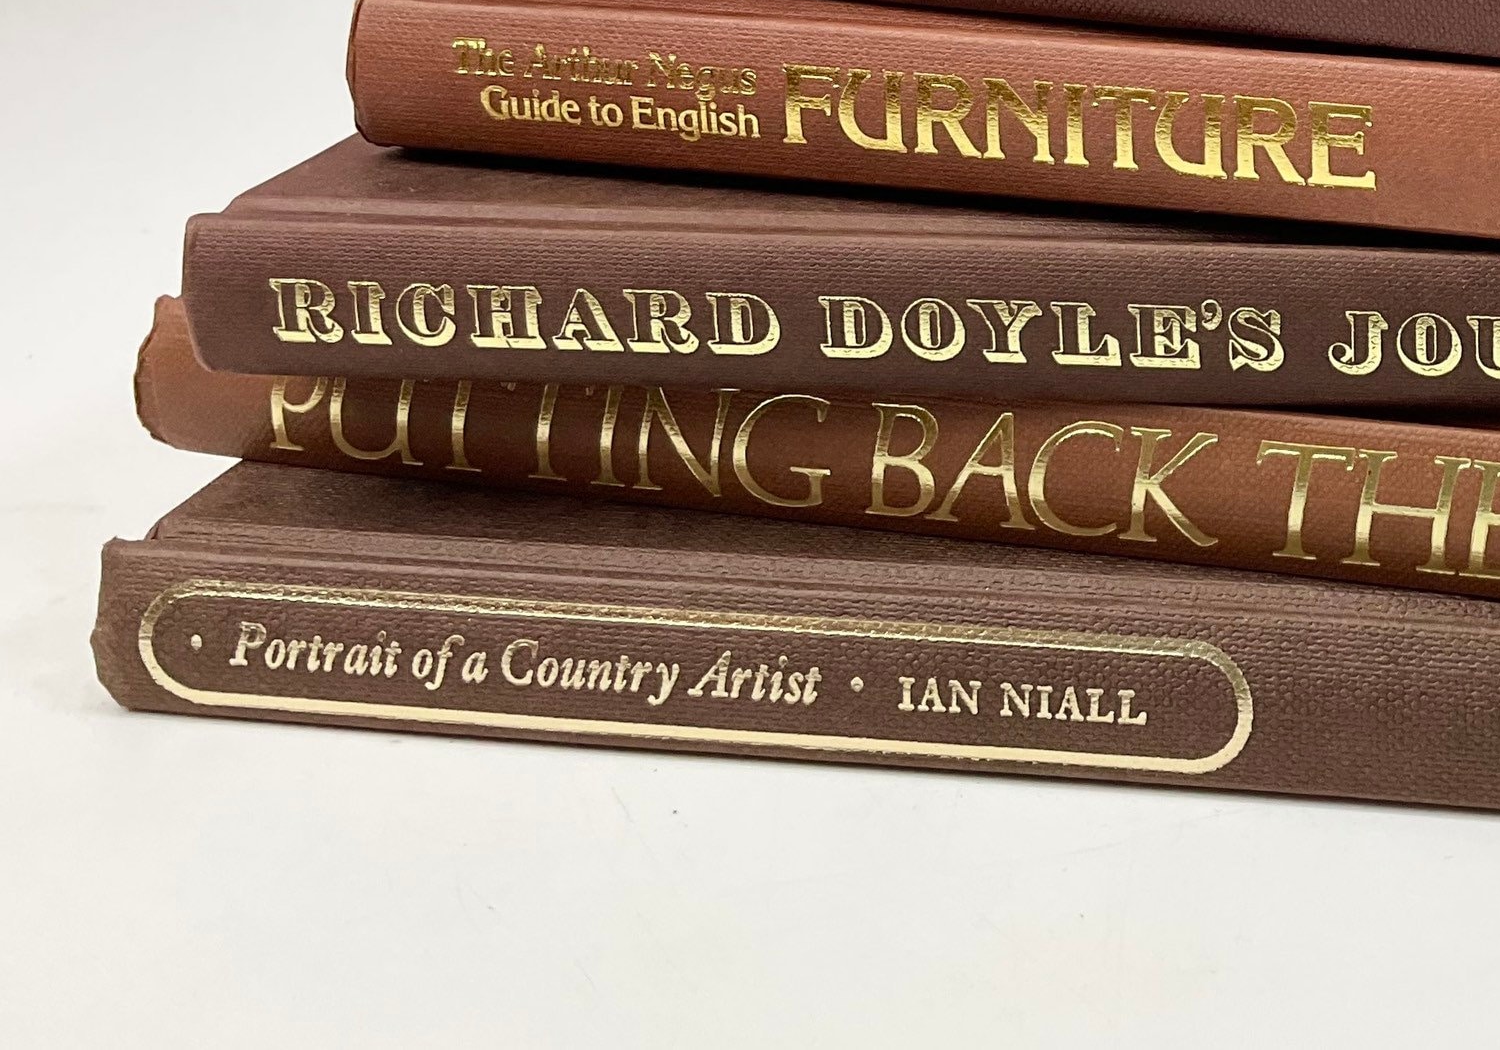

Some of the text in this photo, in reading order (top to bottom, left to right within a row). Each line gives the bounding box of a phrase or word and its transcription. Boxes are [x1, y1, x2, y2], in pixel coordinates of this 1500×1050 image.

[452, 36, 757, 101] The Arthur Negus
[480, 85, 761, 142] Guide to English
[780, 62, 1377, 191] FURNITURE
[269, 277, 781, 355] RICHARD
[864, 400, 1219, 547] BACK
[228, 621, 820, 706] Portrait of a Country Artist
[895, 676, 1148, 727] IAN NIALL
